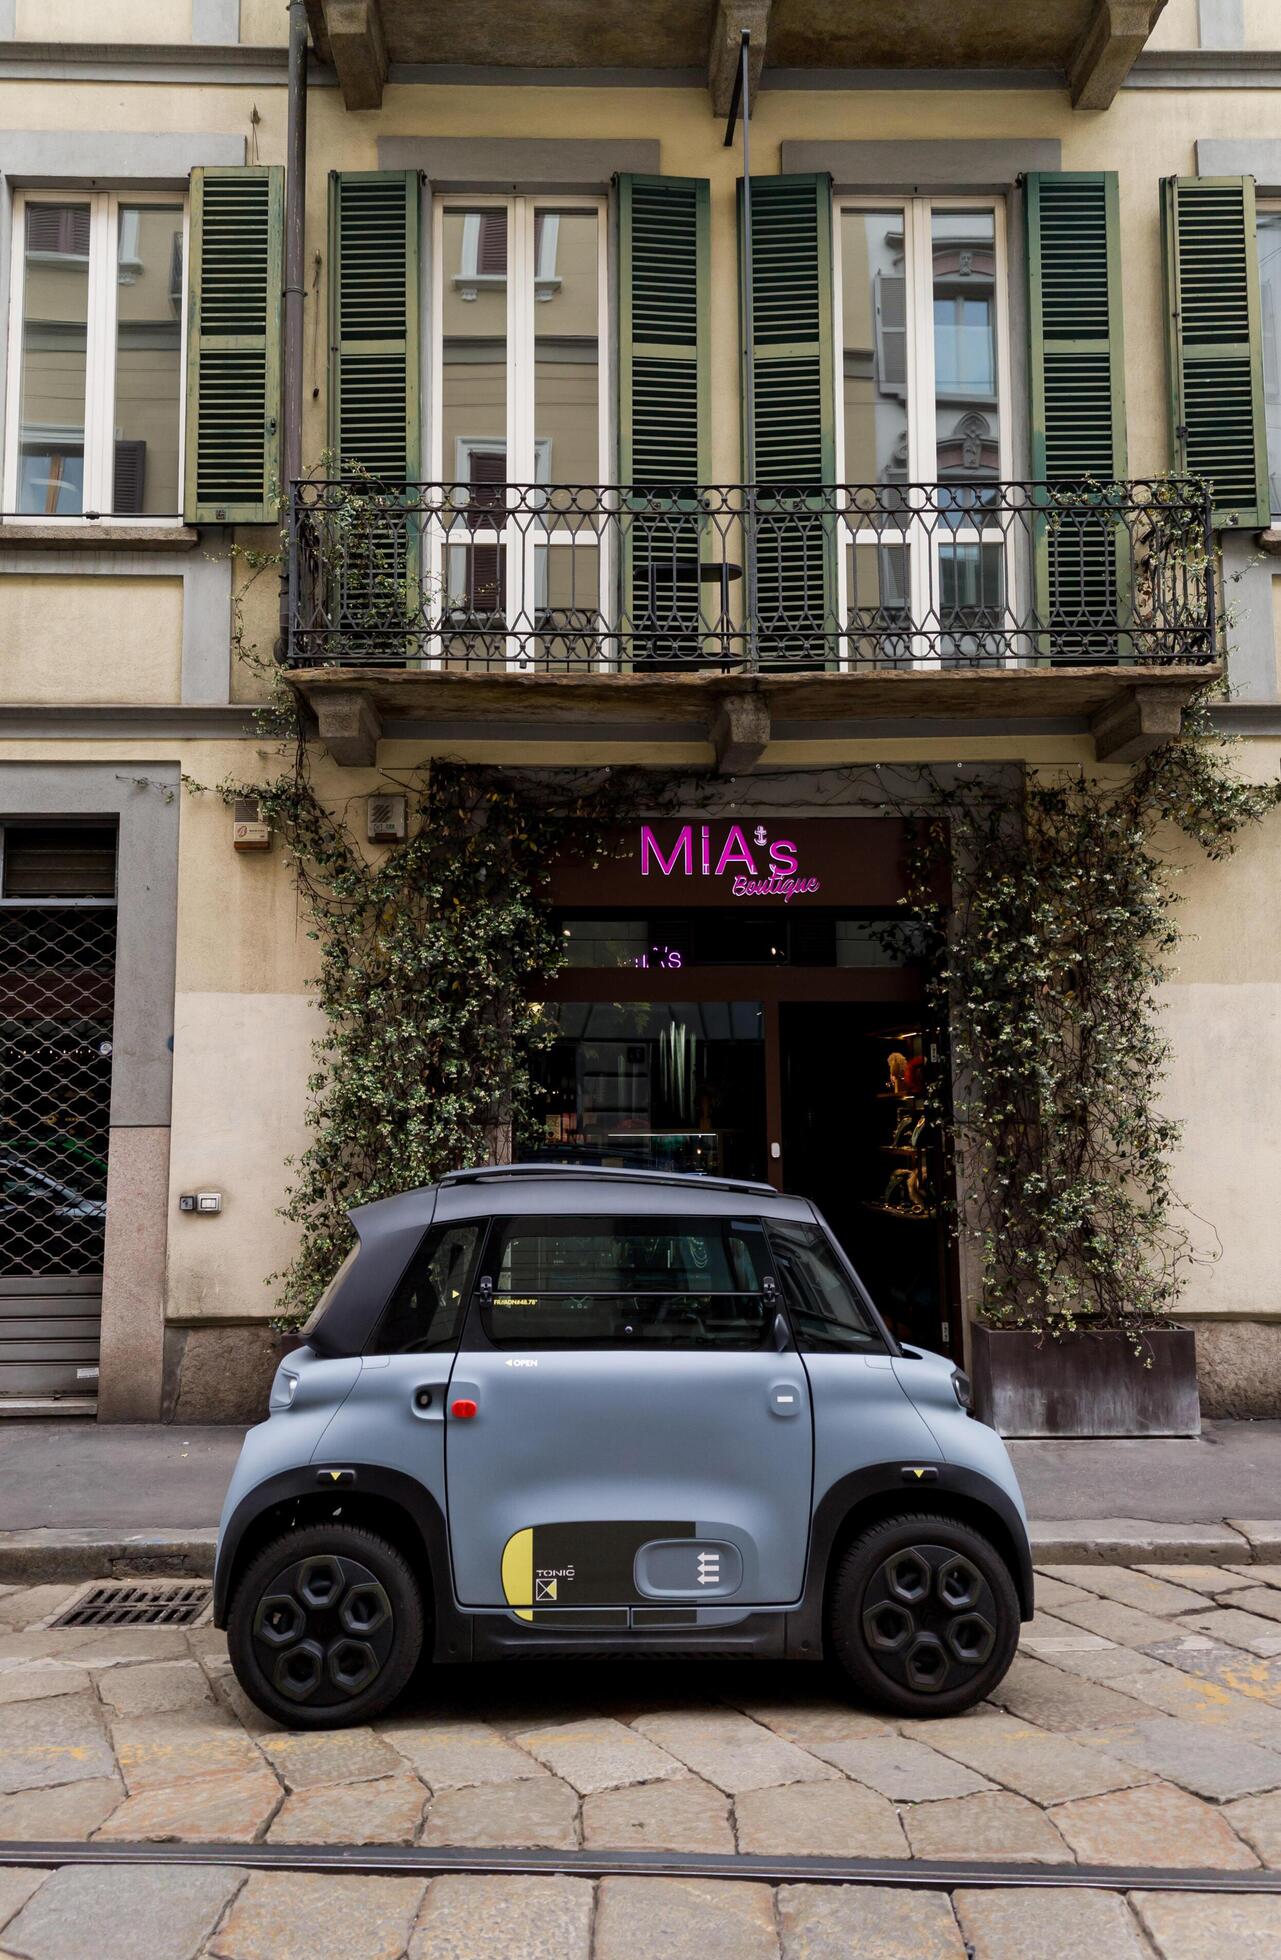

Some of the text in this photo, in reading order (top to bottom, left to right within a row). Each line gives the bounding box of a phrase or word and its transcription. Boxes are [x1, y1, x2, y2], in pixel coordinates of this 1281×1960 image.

[732, 873, 820, 903] Boutique
[513, 1359, 538, 1367] OPEN
[536, 1568, 575, 1577] TONIC
